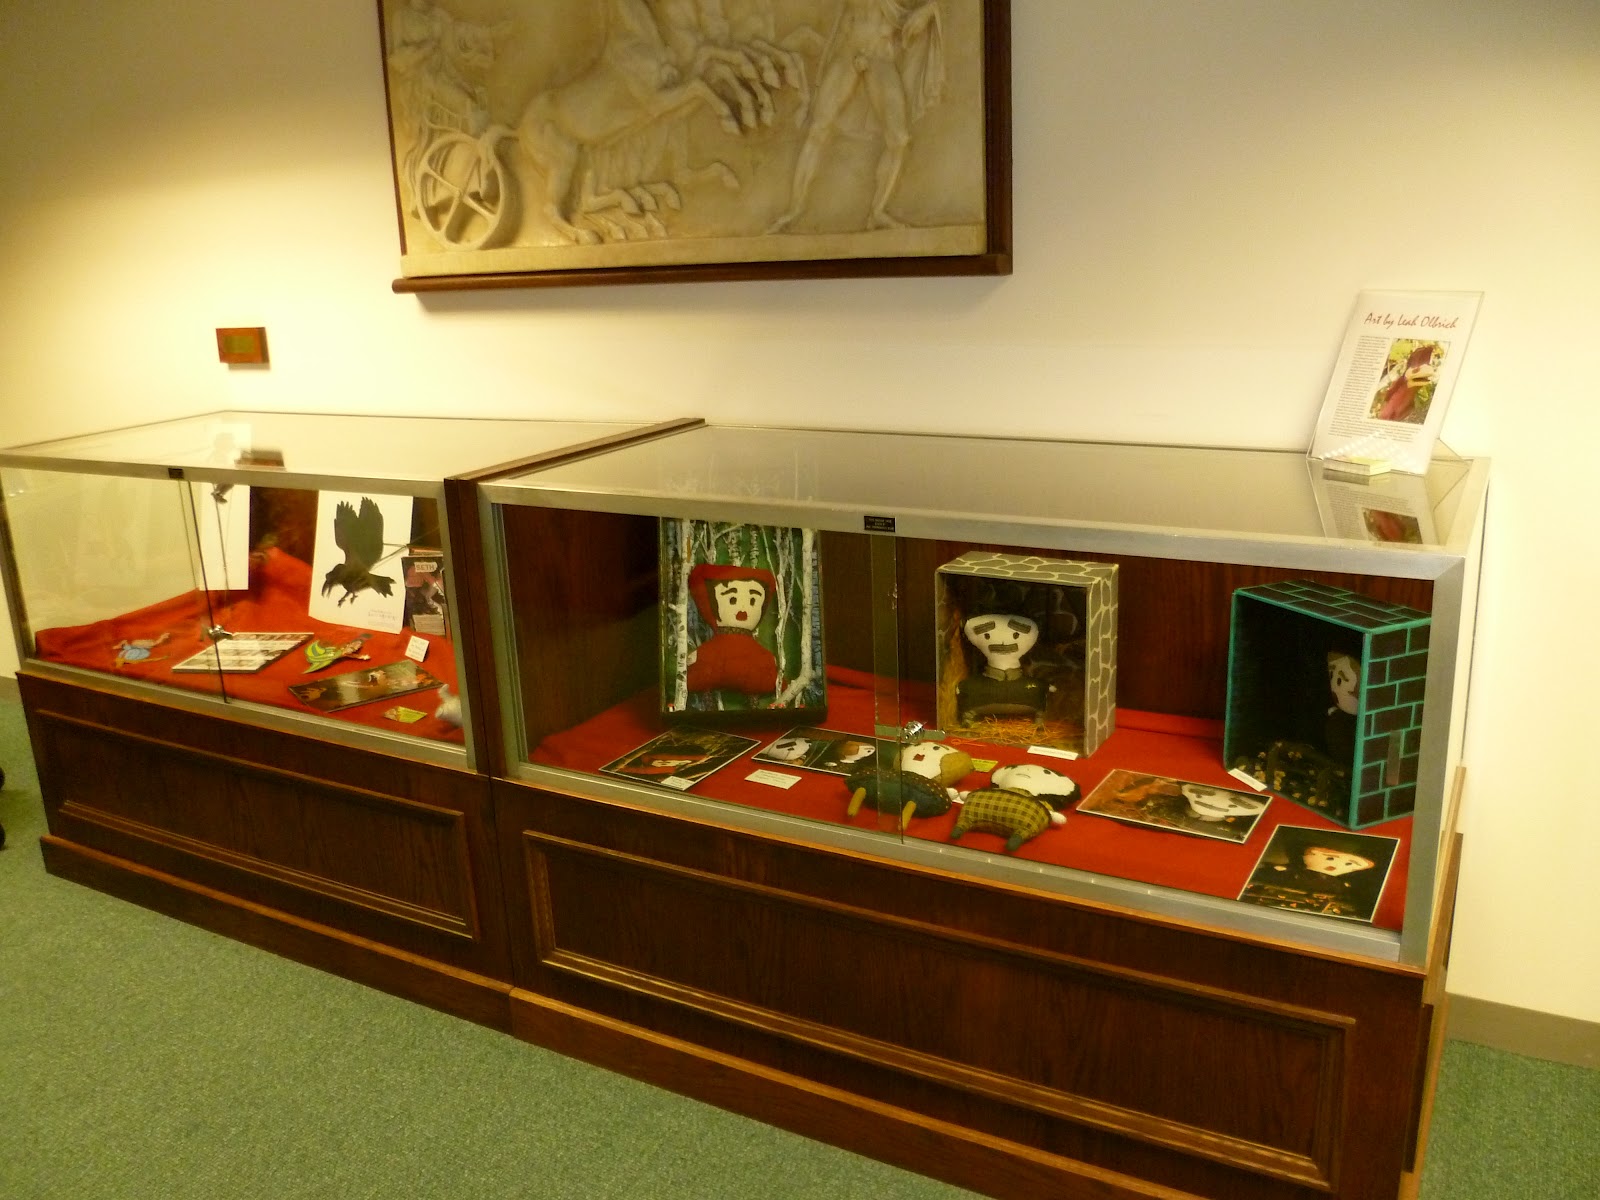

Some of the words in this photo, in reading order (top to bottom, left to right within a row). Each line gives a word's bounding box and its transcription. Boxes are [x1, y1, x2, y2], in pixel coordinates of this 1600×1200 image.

[1364, 312, 1382, 325] Art
[1383, 313, 1394, 329] by
[1397, 314, 1420, 326] Leah
